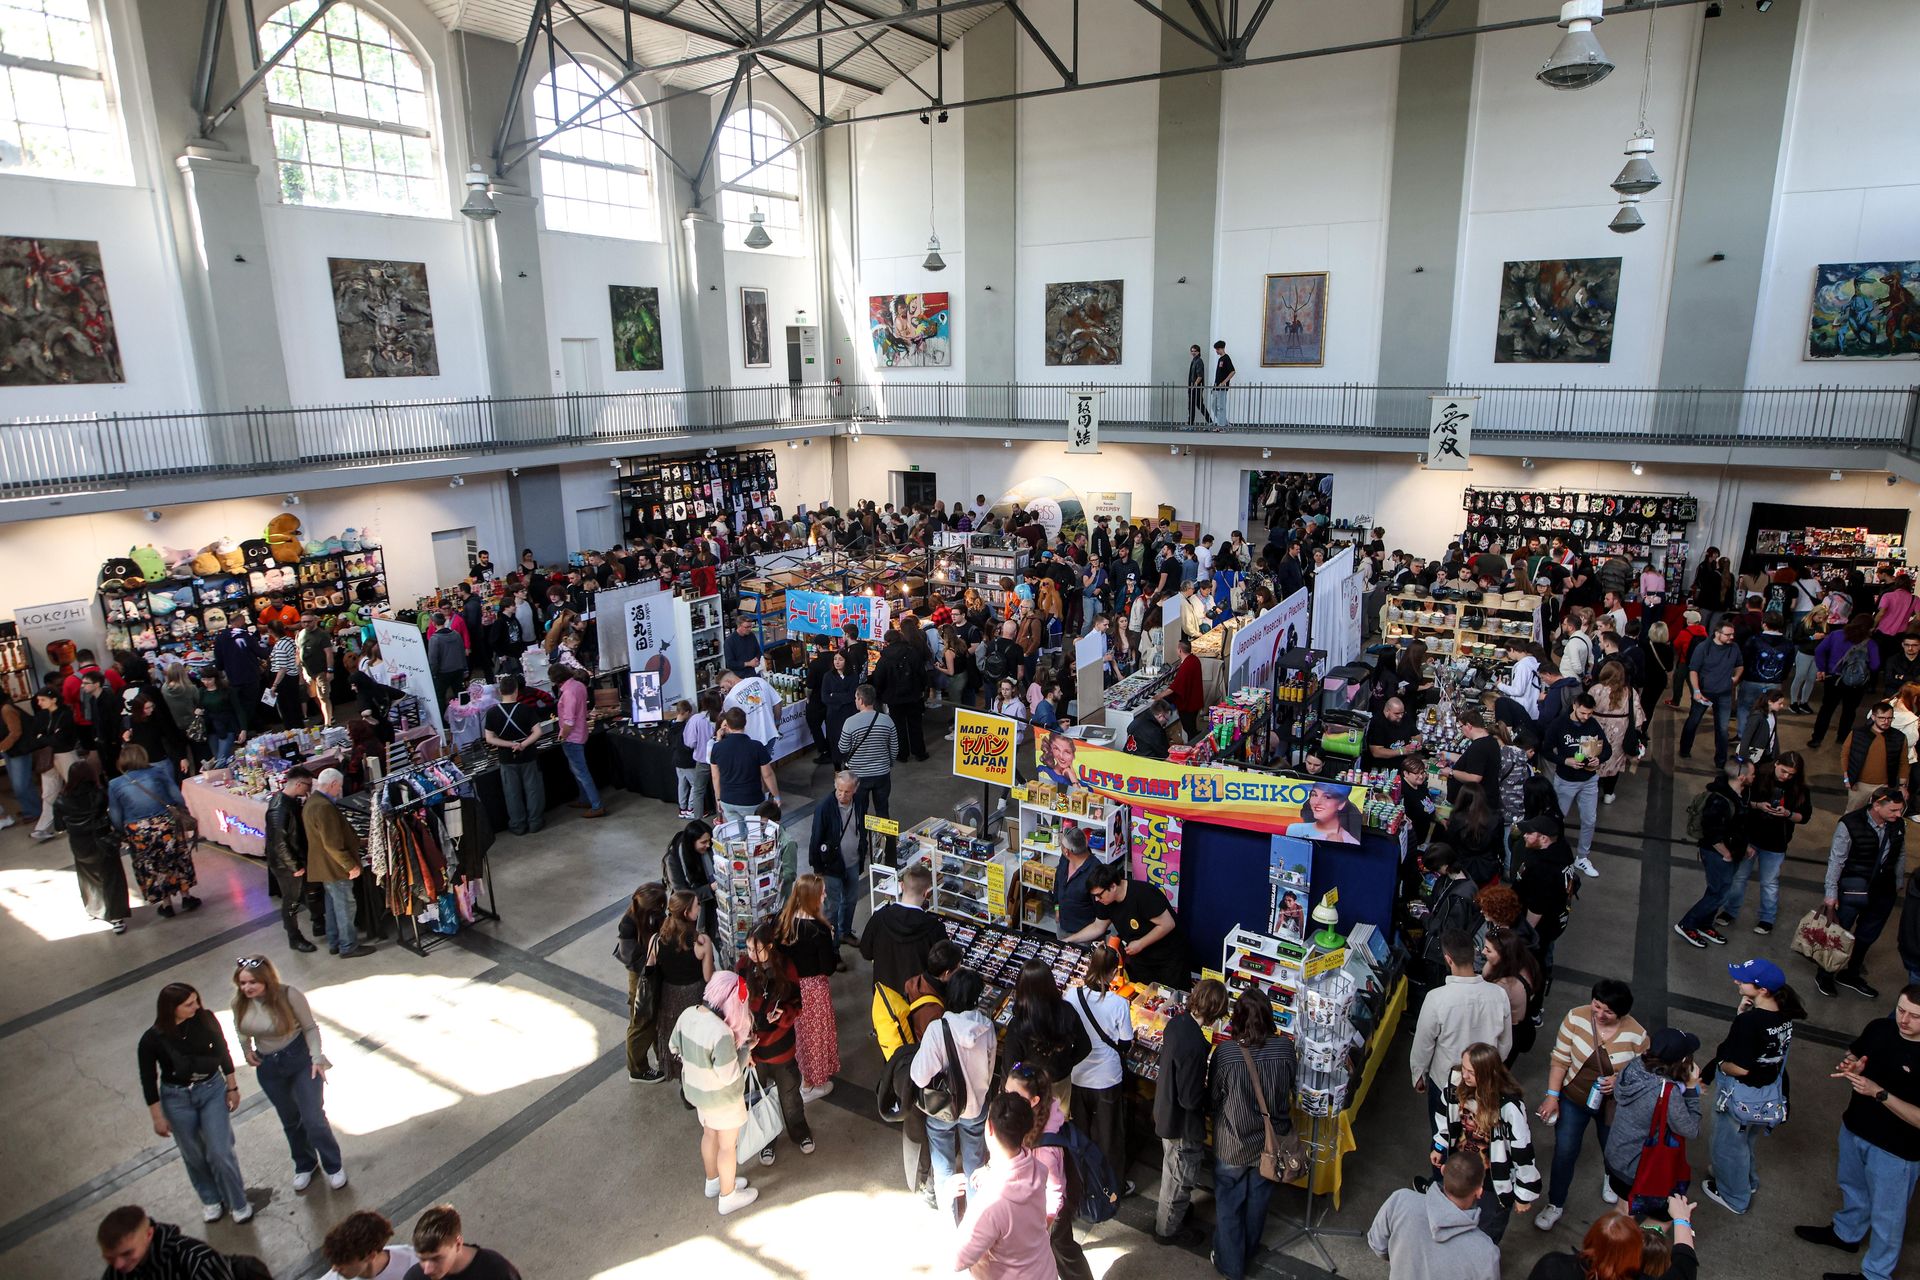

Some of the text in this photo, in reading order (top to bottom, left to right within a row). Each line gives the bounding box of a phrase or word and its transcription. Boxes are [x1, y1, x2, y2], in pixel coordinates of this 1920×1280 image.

[631, 604, 648, 651] 酒丸田
[960, 725, 1009, 735] MADE IN
[963, 755, 1008, 767] JAPAN
[986, 766, 1006, 774] shop
[1079, 765, 1124, 790] LET'S
[1127, 776, 1181, 800] START
[1225, 782, 1309, 804] SEIKO
[1142, 809, 1169, 896] でかで
[1766, 1026, 1783, 1035] Tokyo
